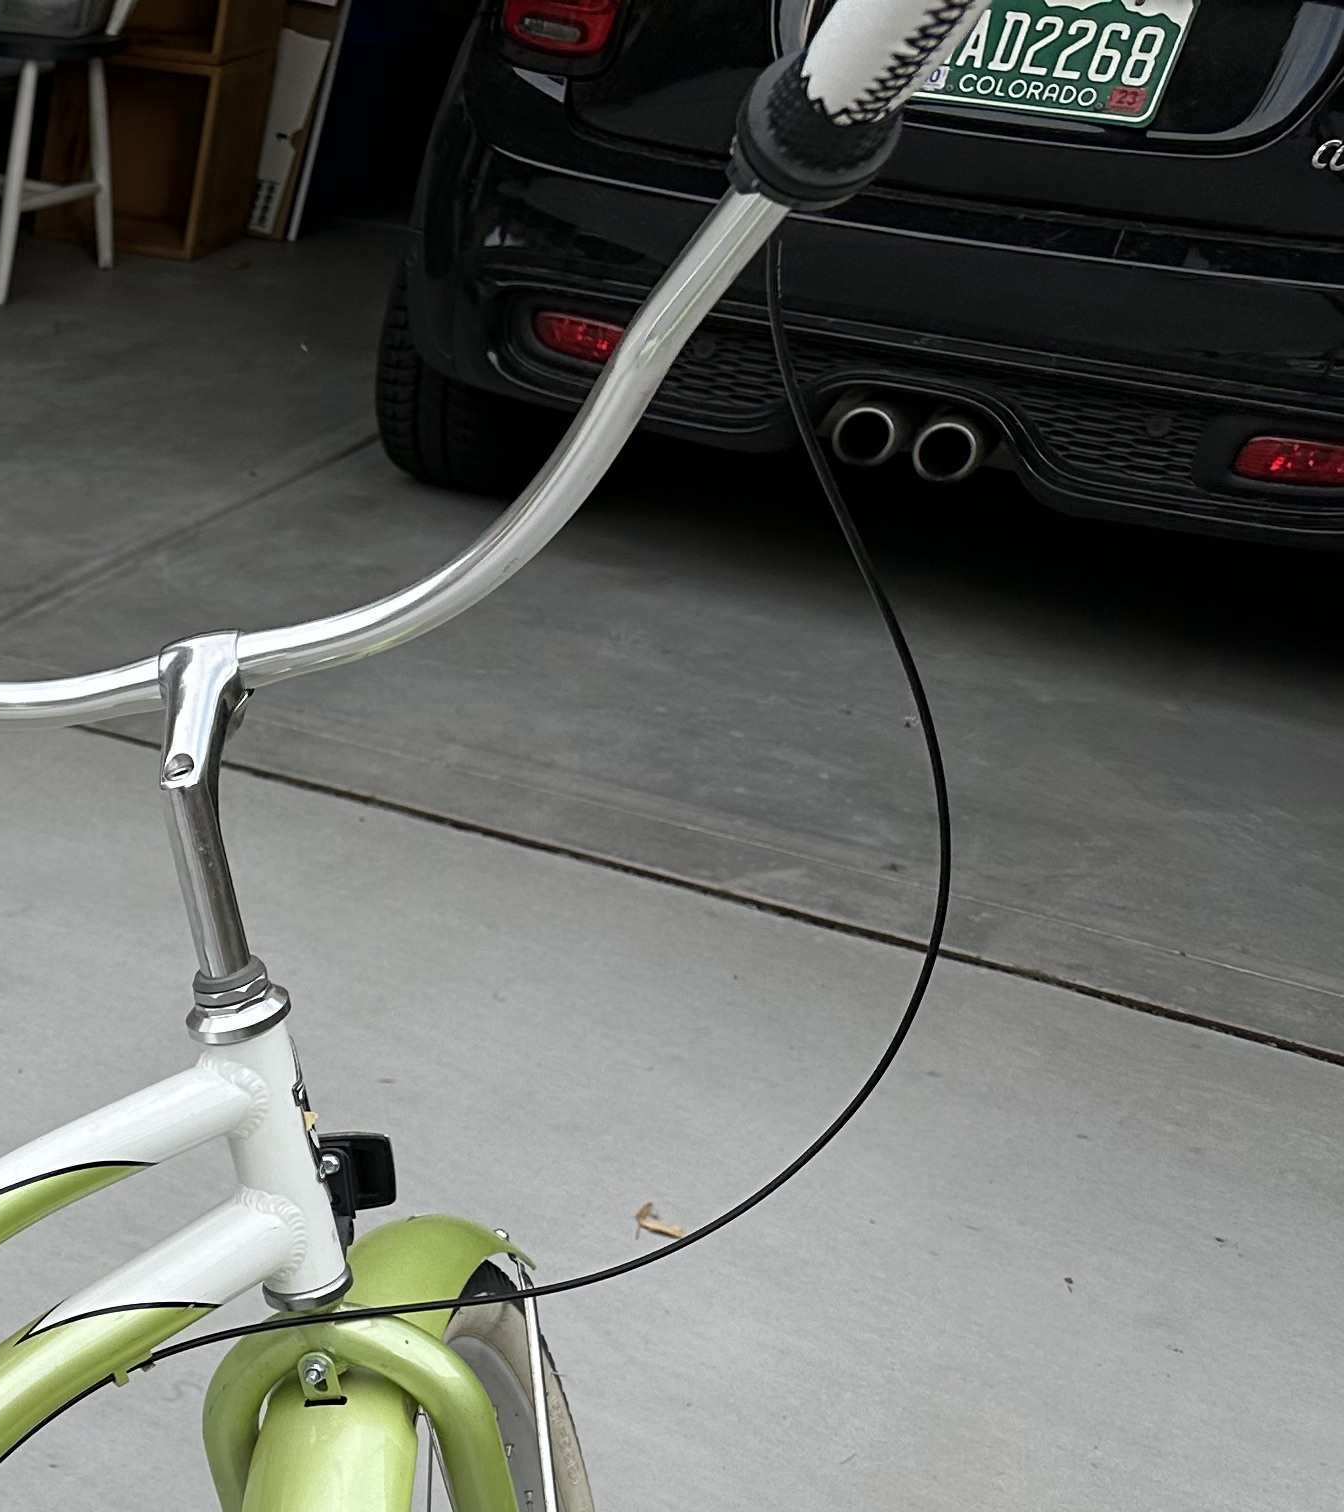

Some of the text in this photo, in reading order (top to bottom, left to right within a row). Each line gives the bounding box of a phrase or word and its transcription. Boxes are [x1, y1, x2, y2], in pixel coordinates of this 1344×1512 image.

[943, 9, 1166, 87] AD2268
[959, 73, 1098, 106] COLORADO
[1115, 89, 1139, 105] 23
